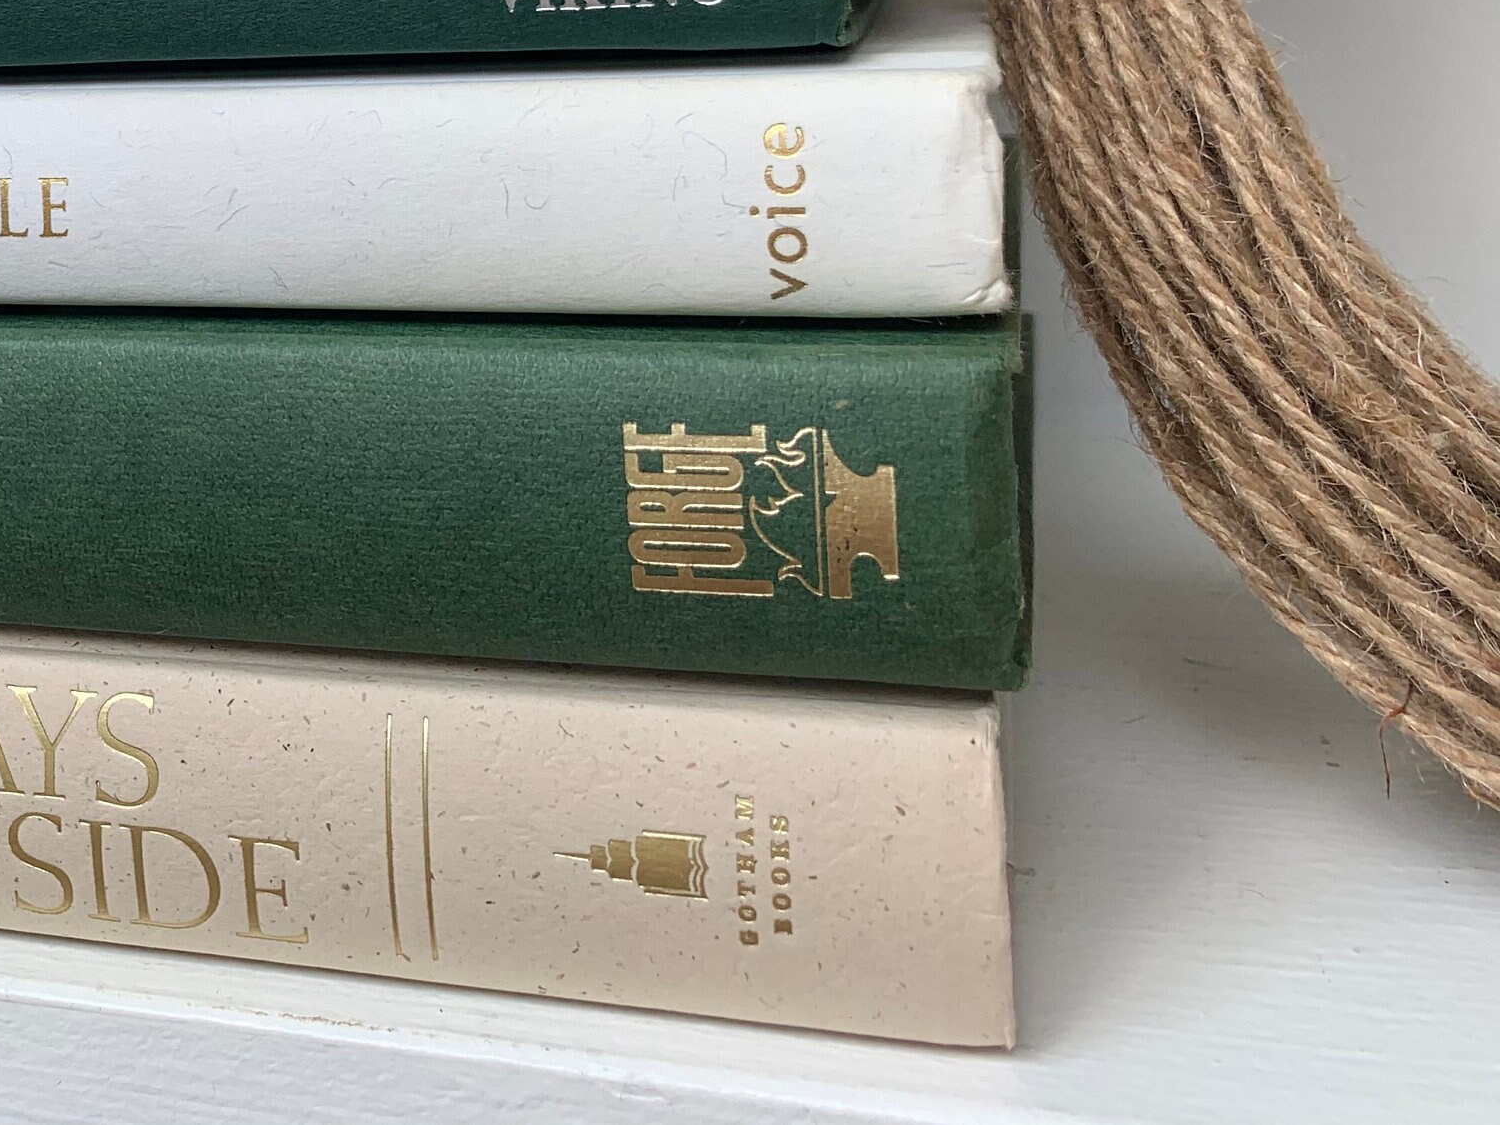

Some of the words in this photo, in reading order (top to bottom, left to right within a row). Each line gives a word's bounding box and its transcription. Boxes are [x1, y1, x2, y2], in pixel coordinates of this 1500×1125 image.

[749, 121, 808, 300] voice
[622, 422, 774, 597] FORGE
[8, 812, 310, 944] SIDE
[734, 794, 759, 947] GOTHAM
[769, 814, 793, 936] BOOKS
